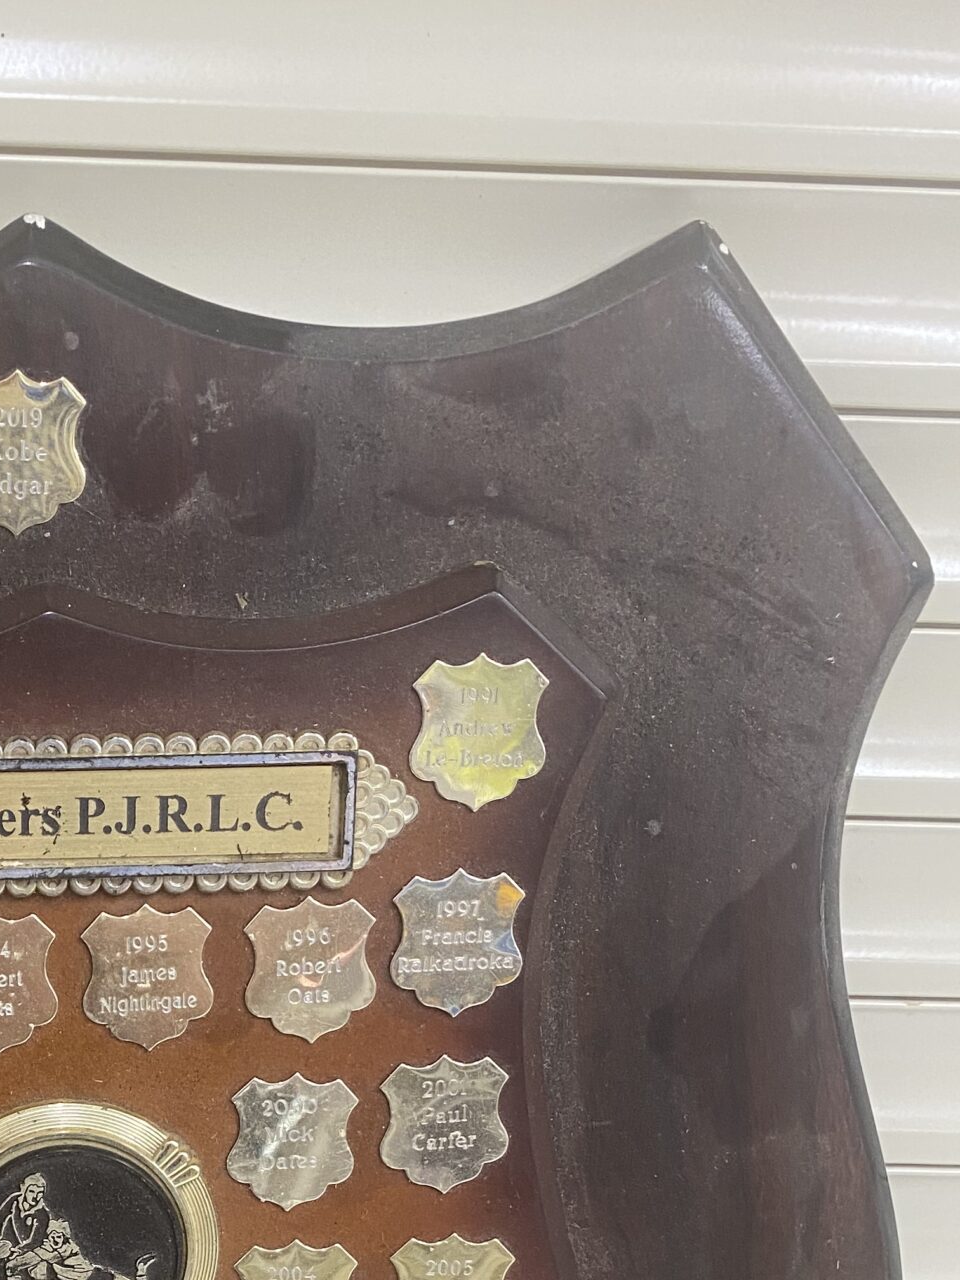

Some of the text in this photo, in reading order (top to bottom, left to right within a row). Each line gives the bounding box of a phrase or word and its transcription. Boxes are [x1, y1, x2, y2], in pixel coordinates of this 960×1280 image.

[460, 687, 499, 704] 1991
[440, 721, 513, 736] Andrew
[75, 791, 304, 835] P.J.R.L.C.
[436, 900, 481, 918] 1997
[125, 935, 169, 954] 1995
[286, 926, 331, 951] 1996
[421, 929, 493, 945] Francis
[120, 965, 176, 987] James
[276, 956, 341, 977] Robert
[99, 993, 198, 1015] Nightingale
[287, 987, 330, 1006] Oats
[421, 1079, 468, 1098] 2001
[421, 1105, 468, 1124] Paul
[411, 1133, 477, 1151] Carter
[425, 1260, 474, 1276] 2005
